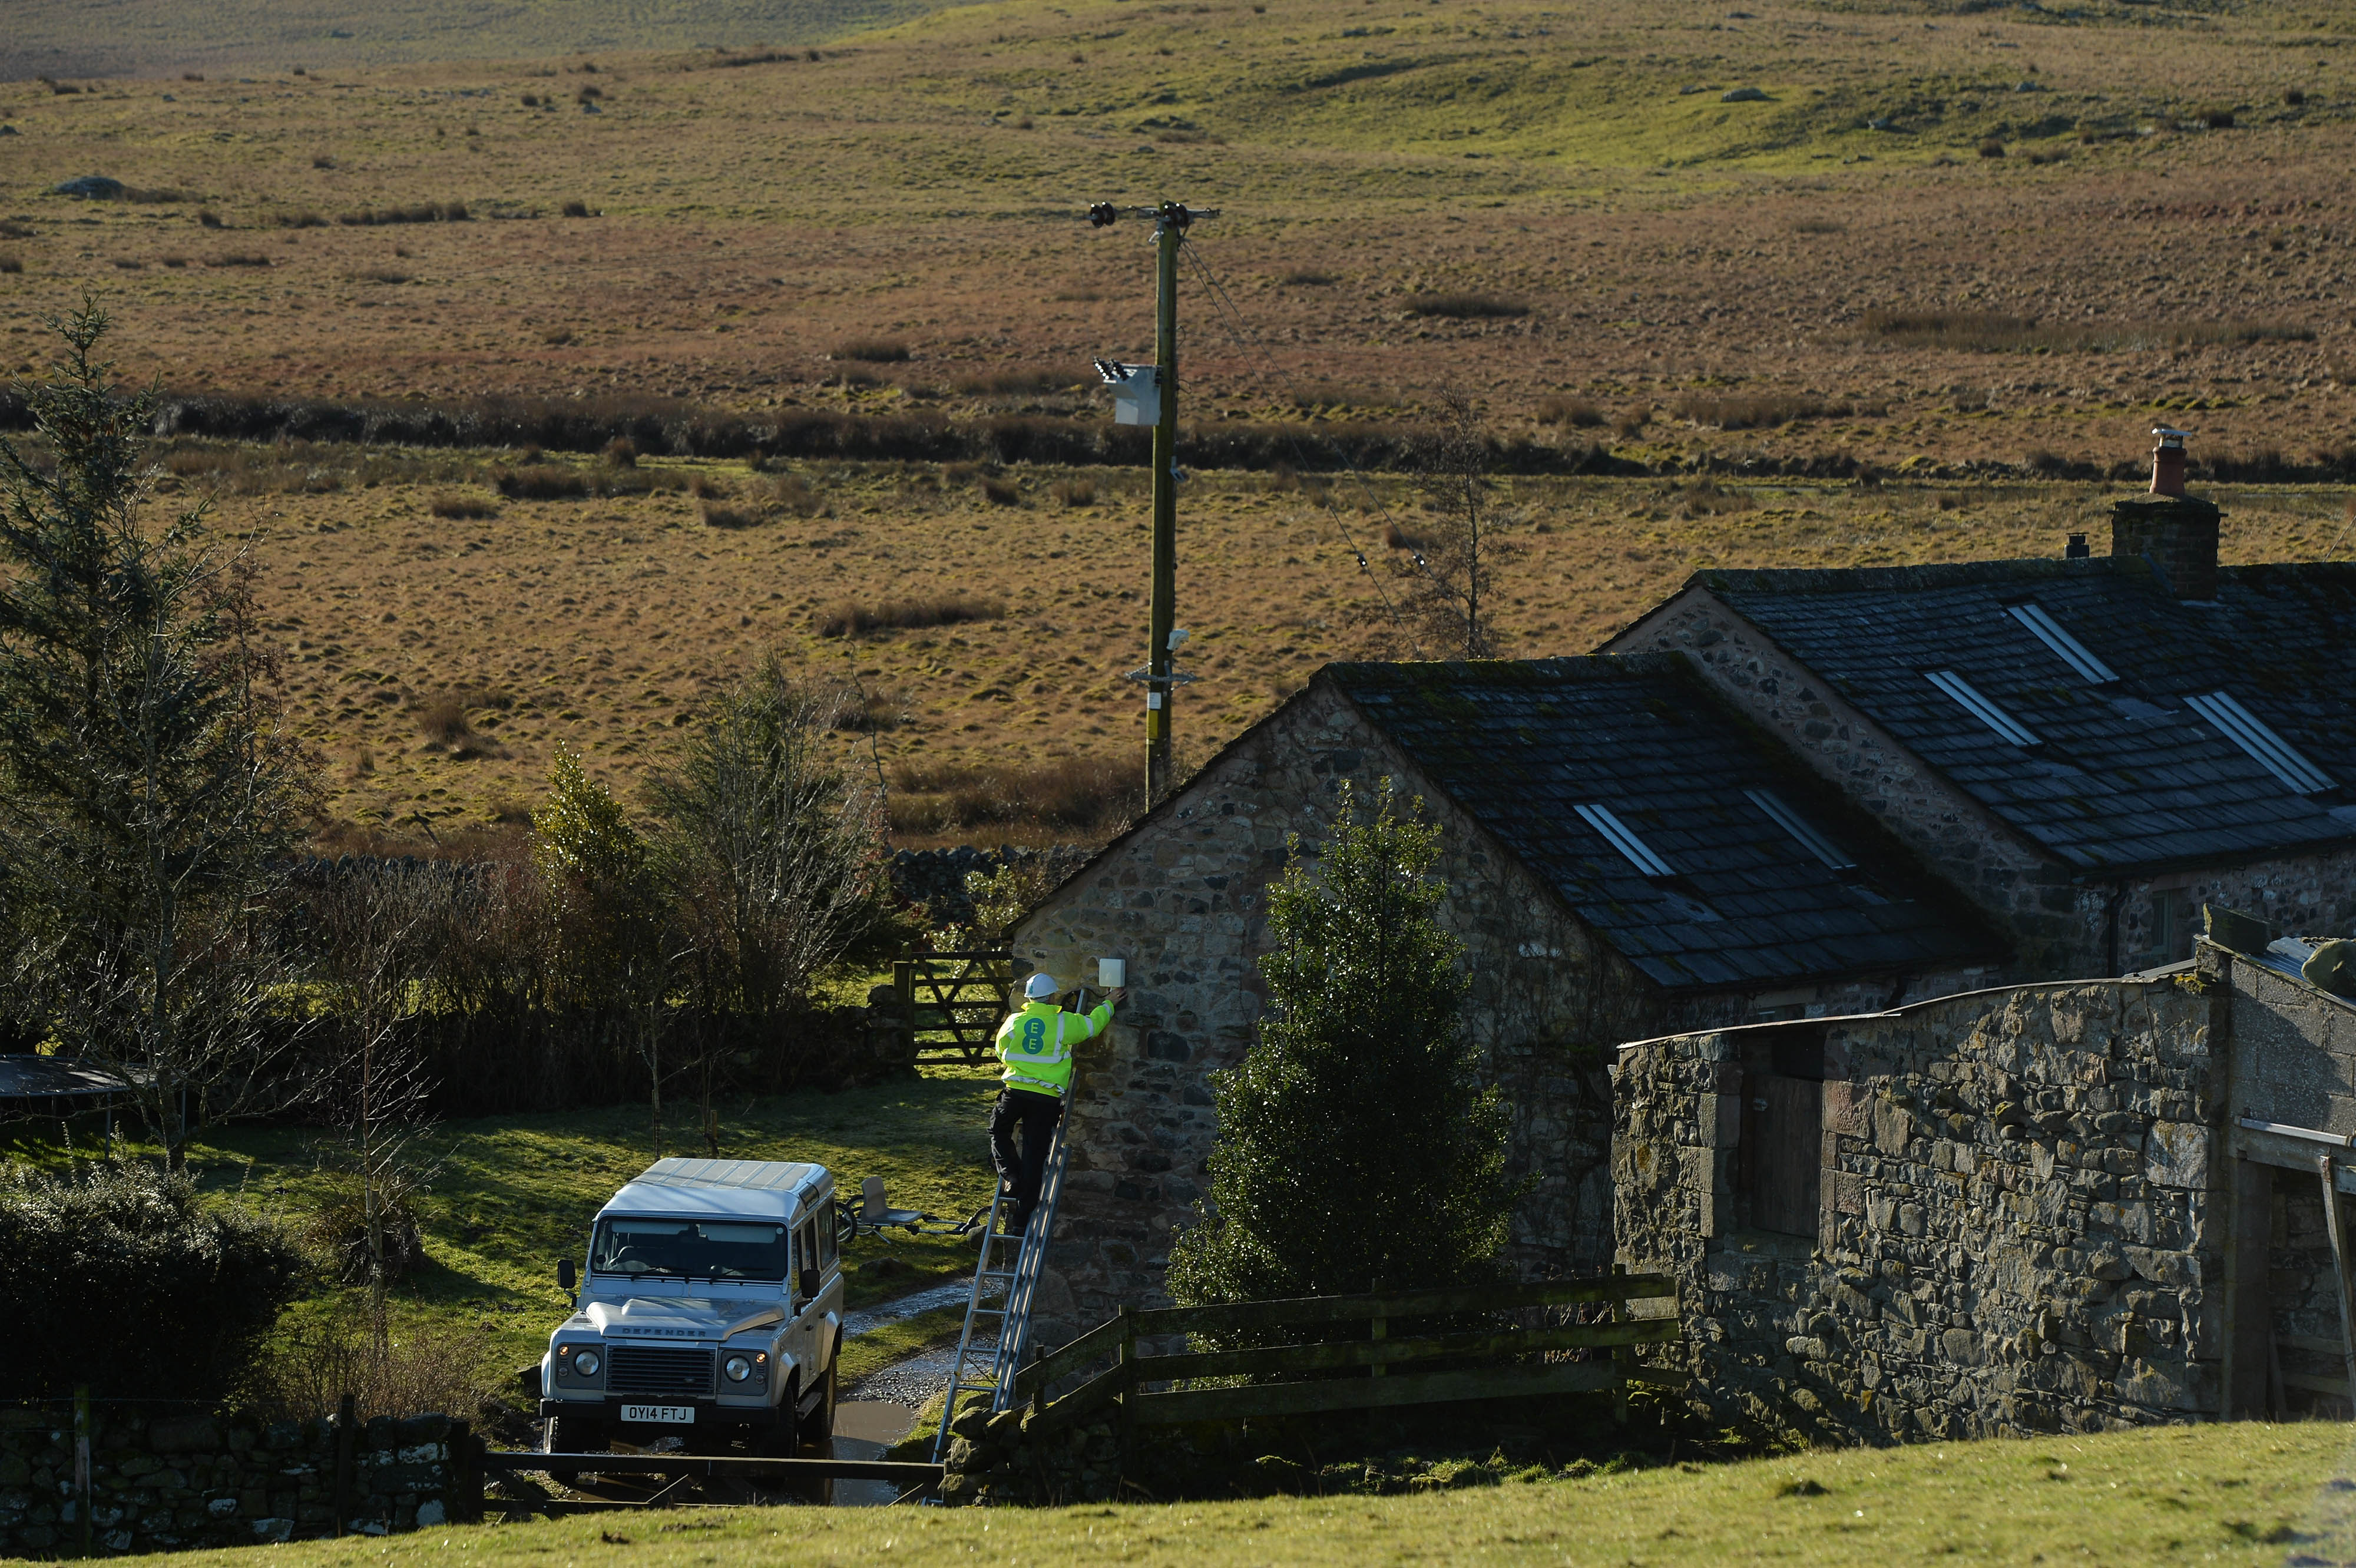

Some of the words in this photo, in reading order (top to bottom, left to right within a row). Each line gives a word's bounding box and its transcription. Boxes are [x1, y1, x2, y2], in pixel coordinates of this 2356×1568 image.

[622, 1328, 706, 1337] DEFENDER
[629, 1407, 658, 1420] OY14
[661, 1407, 687, 1421] FTJ
